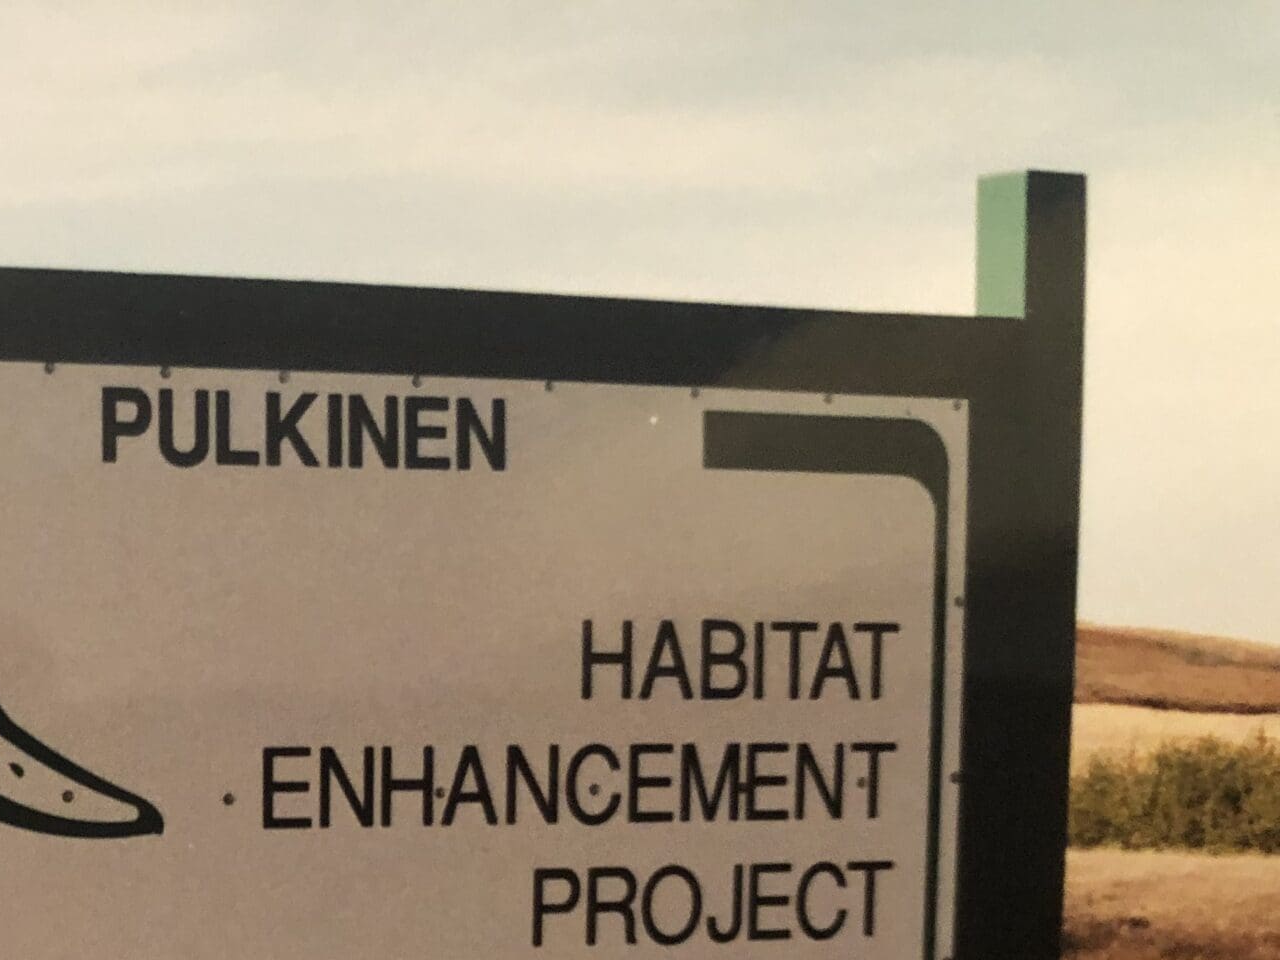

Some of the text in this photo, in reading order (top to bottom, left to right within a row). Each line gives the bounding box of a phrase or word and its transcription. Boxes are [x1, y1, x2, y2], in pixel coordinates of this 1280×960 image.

[101, 386, 507, 471] PULKINEN
[580, 619, 900, 700] HABITAT
[262, 741, 898, 829] ENHANCEMENT
[532, 860, 895, 948] PROJECT
